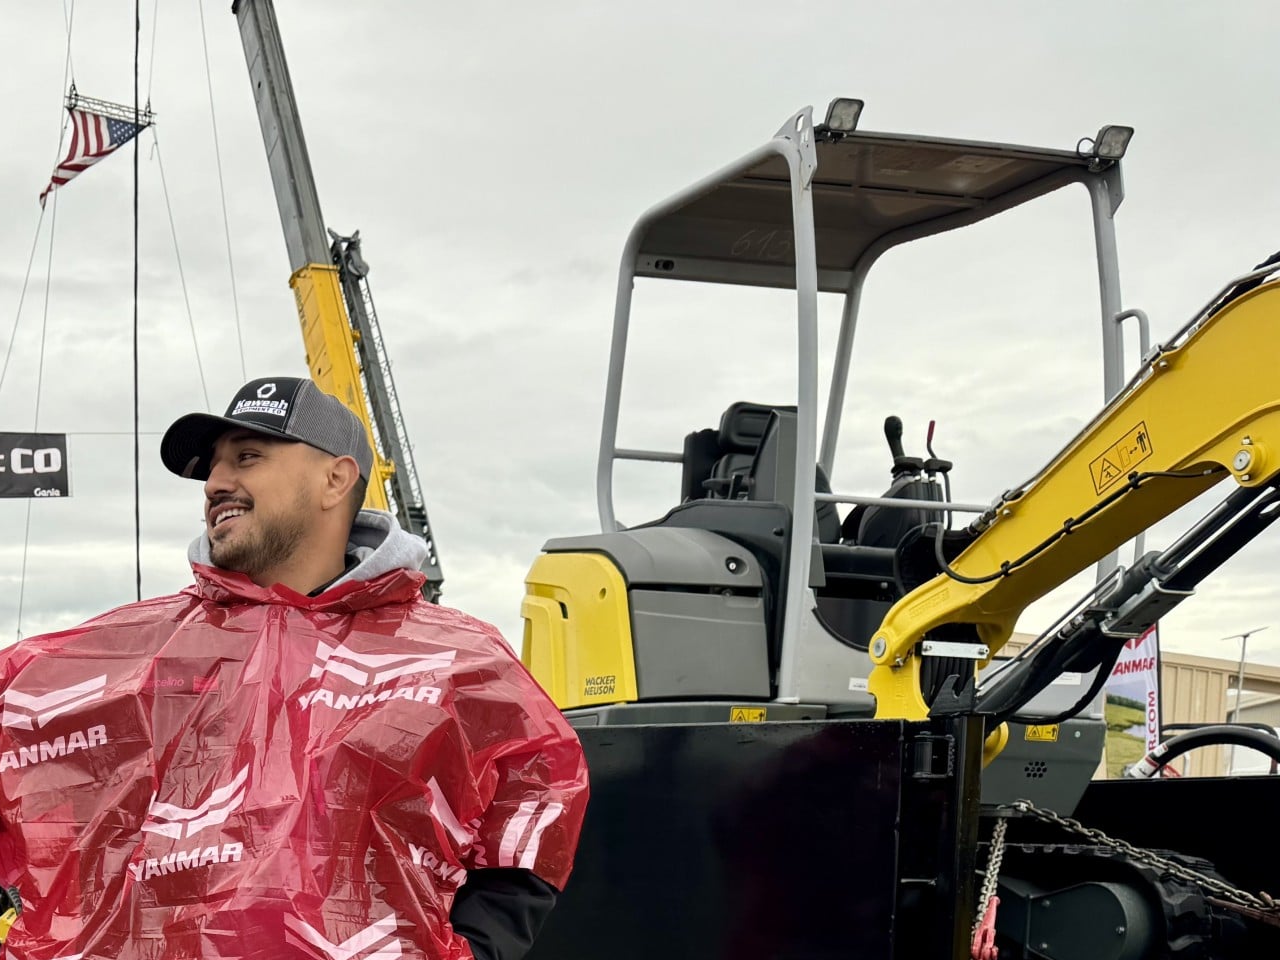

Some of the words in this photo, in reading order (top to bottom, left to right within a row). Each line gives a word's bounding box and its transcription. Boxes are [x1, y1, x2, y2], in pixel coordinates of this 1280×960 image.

[235, 399, 288, 410] Kaweah
[10, 447, 62, 474] CO
[298, 686, 442, 711] YANMAR
[584, 685, 615, 696] NEUSON
[128, 842, 244, 881] YANMAR
